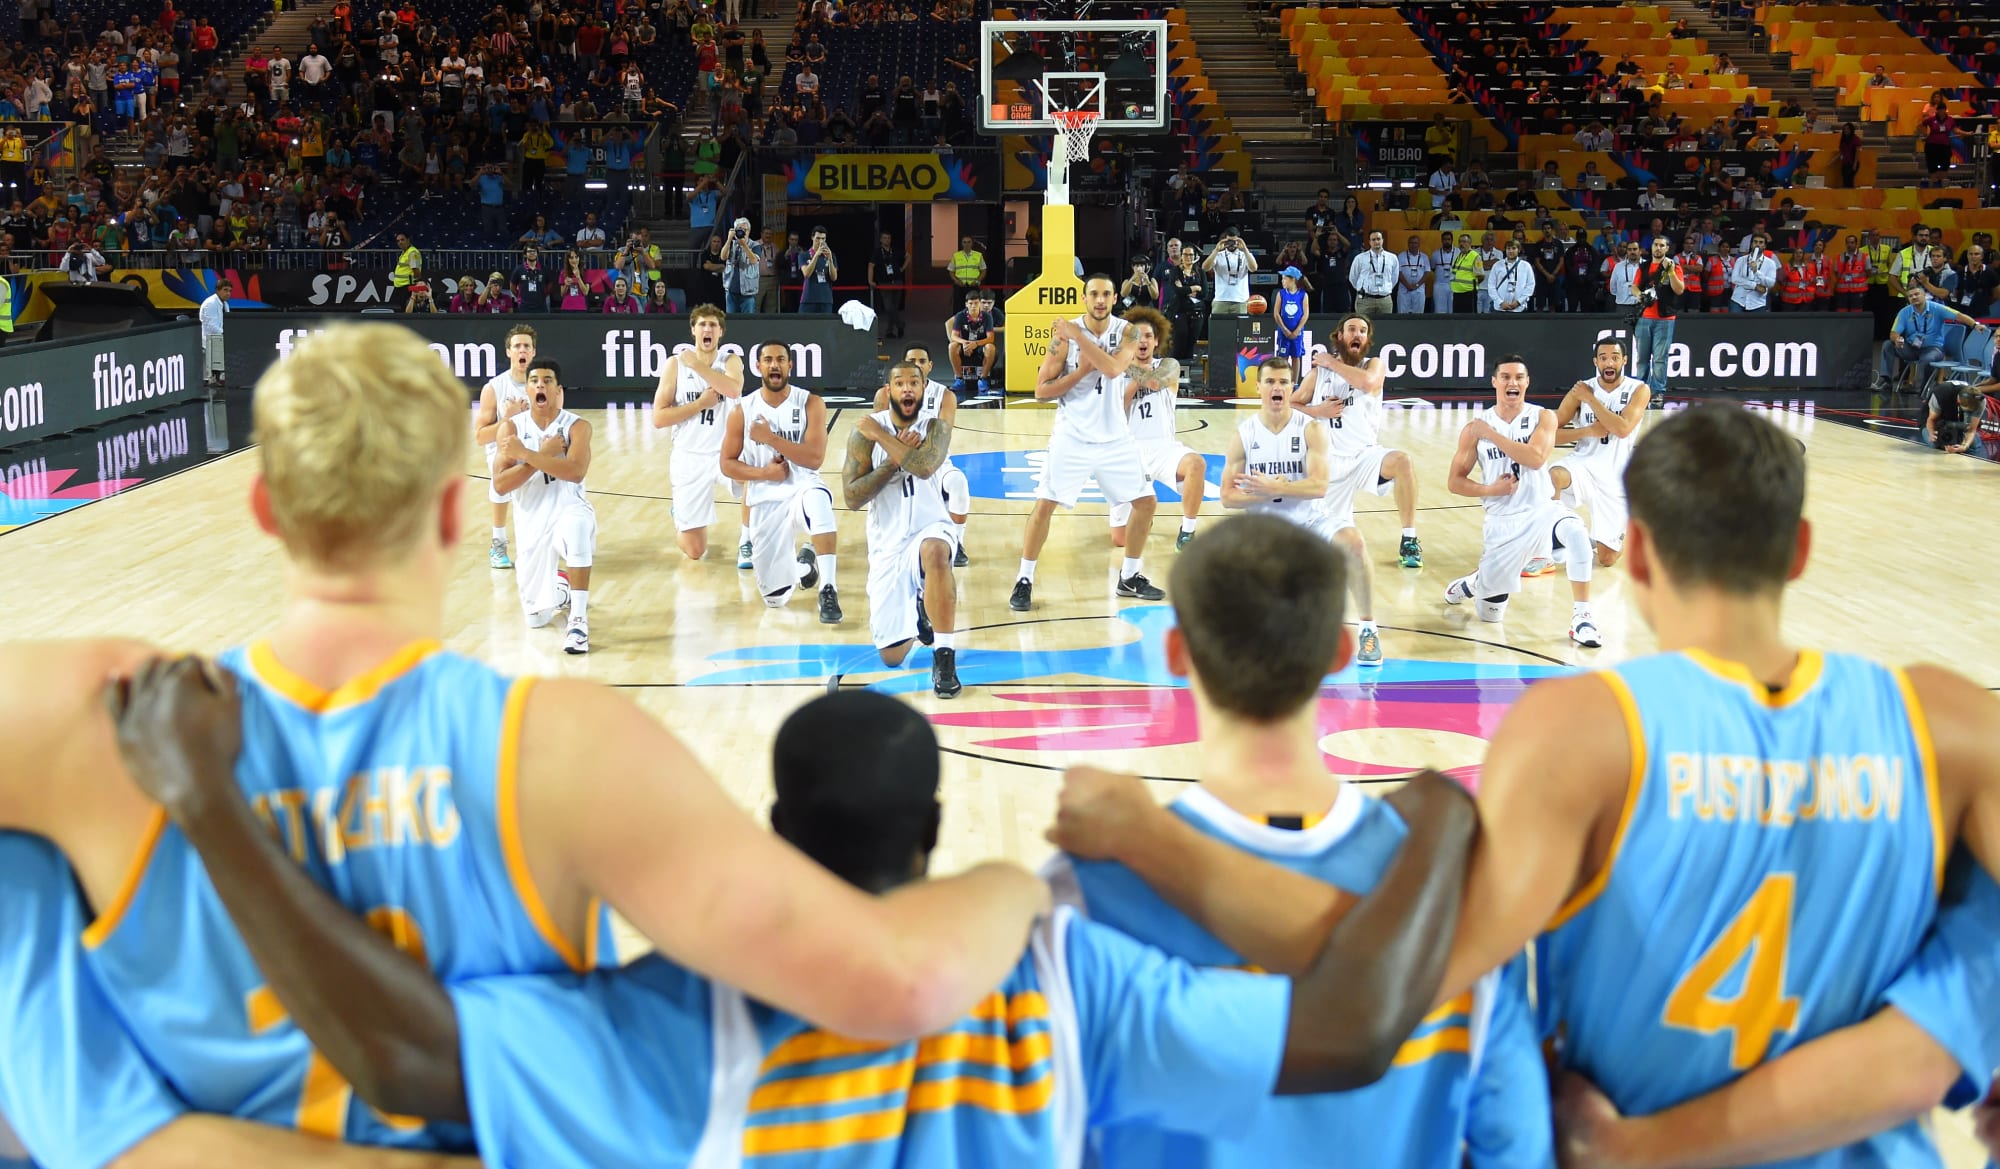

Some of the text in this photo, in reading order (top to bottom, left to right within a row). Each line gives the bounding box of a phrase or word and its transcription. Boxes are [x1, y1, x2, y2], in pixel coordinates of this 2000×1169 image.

[1378, 148, 1422, 161] BILBAO
[819, 164, 937, 190] BILBAO
[1038, 287, 1077, 304] FIBA
[93, 352, 185, 411] fiba.com
[1095, 377, 1103, 394] 4
[0, 381, 44, 432] om
[1139, 402, 1152, 419] 12
[700, 408, 715, 426] 14
[1330, 416, 1342, 429] 13
[1249, 460, 1304, 476] NEW ZEALAND
[902, 474, 915, 498] 11
[1661, 872, 1802, 1071] 4
